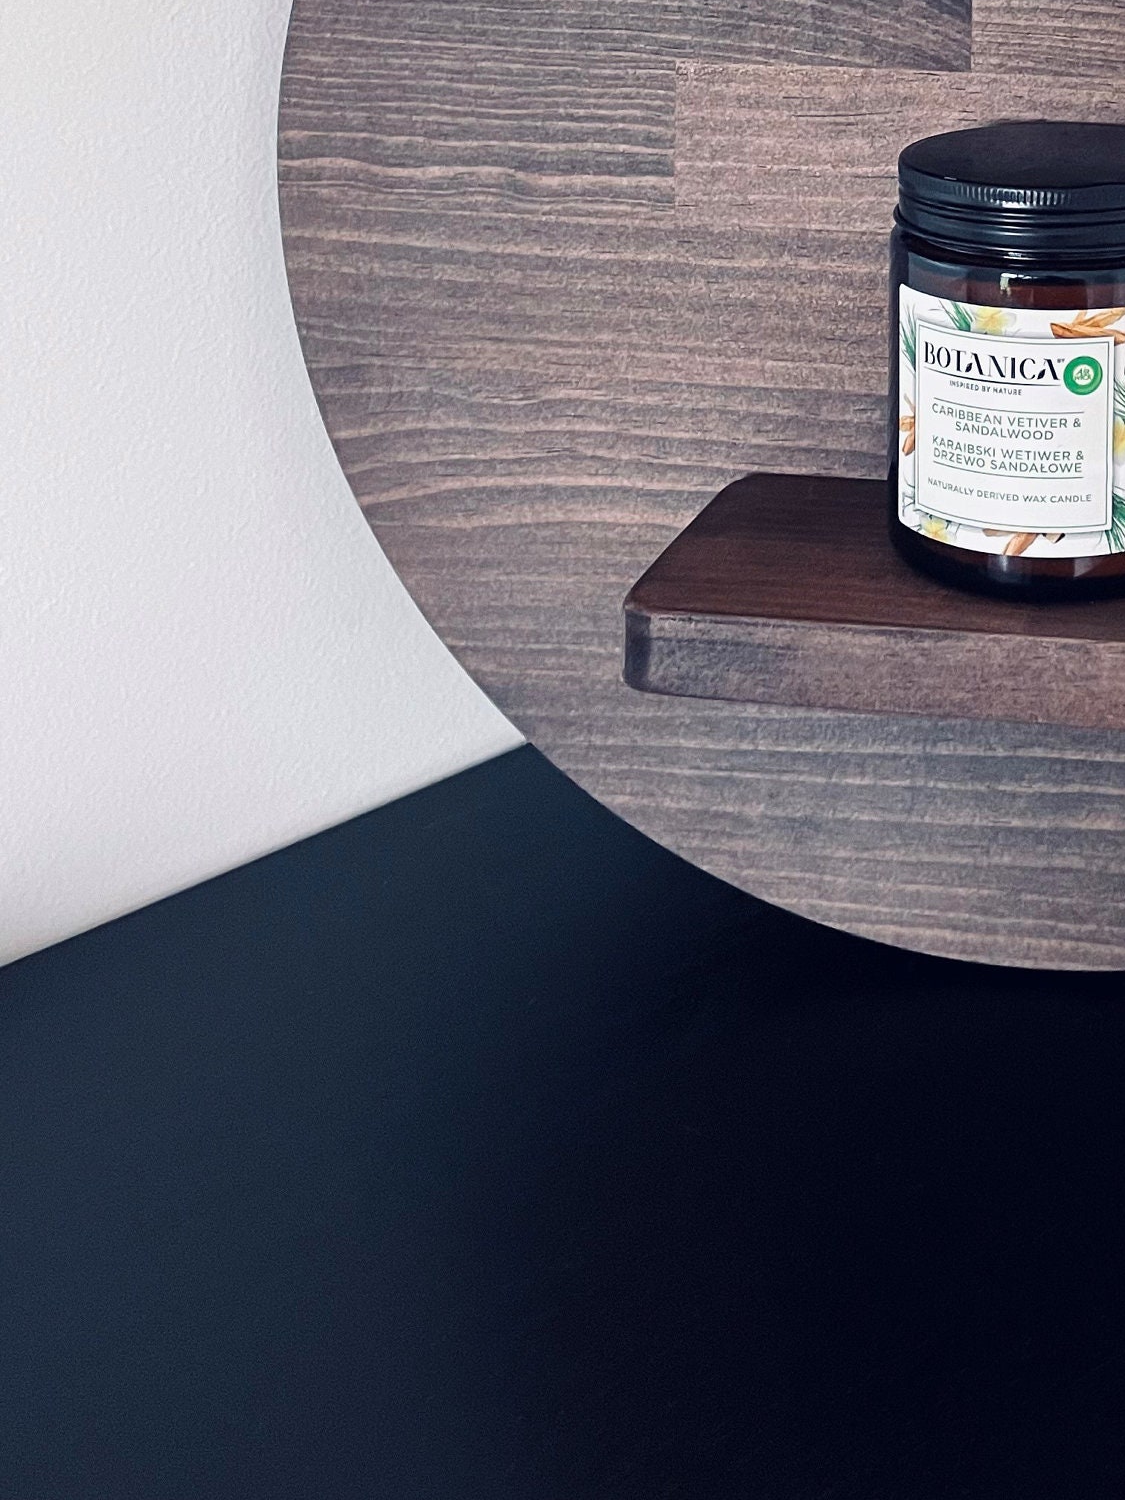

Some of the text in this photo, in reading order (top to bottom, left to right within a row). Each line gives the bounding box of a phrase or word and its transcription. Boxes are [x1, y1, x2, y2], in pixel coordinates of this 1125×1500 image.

[924, 341, 1061, 381] BOTANICA
[949, 380, 979, 392] INSPIRED
[993, 388, 1022, 396] NATURE
[932, 402, 1081, 428] CARIBBEAN VETIVER &
[955, 421, 1054, 441] SANDALWOOD
[932, 435, 1084, 461] KARAIBSKI WETIWER &
[933, 447, 1082, 473] DRZEWO SANDAŁOWE
[927, 477, 1092, 504] NATURALLY DERIVED WAX CANDLE
